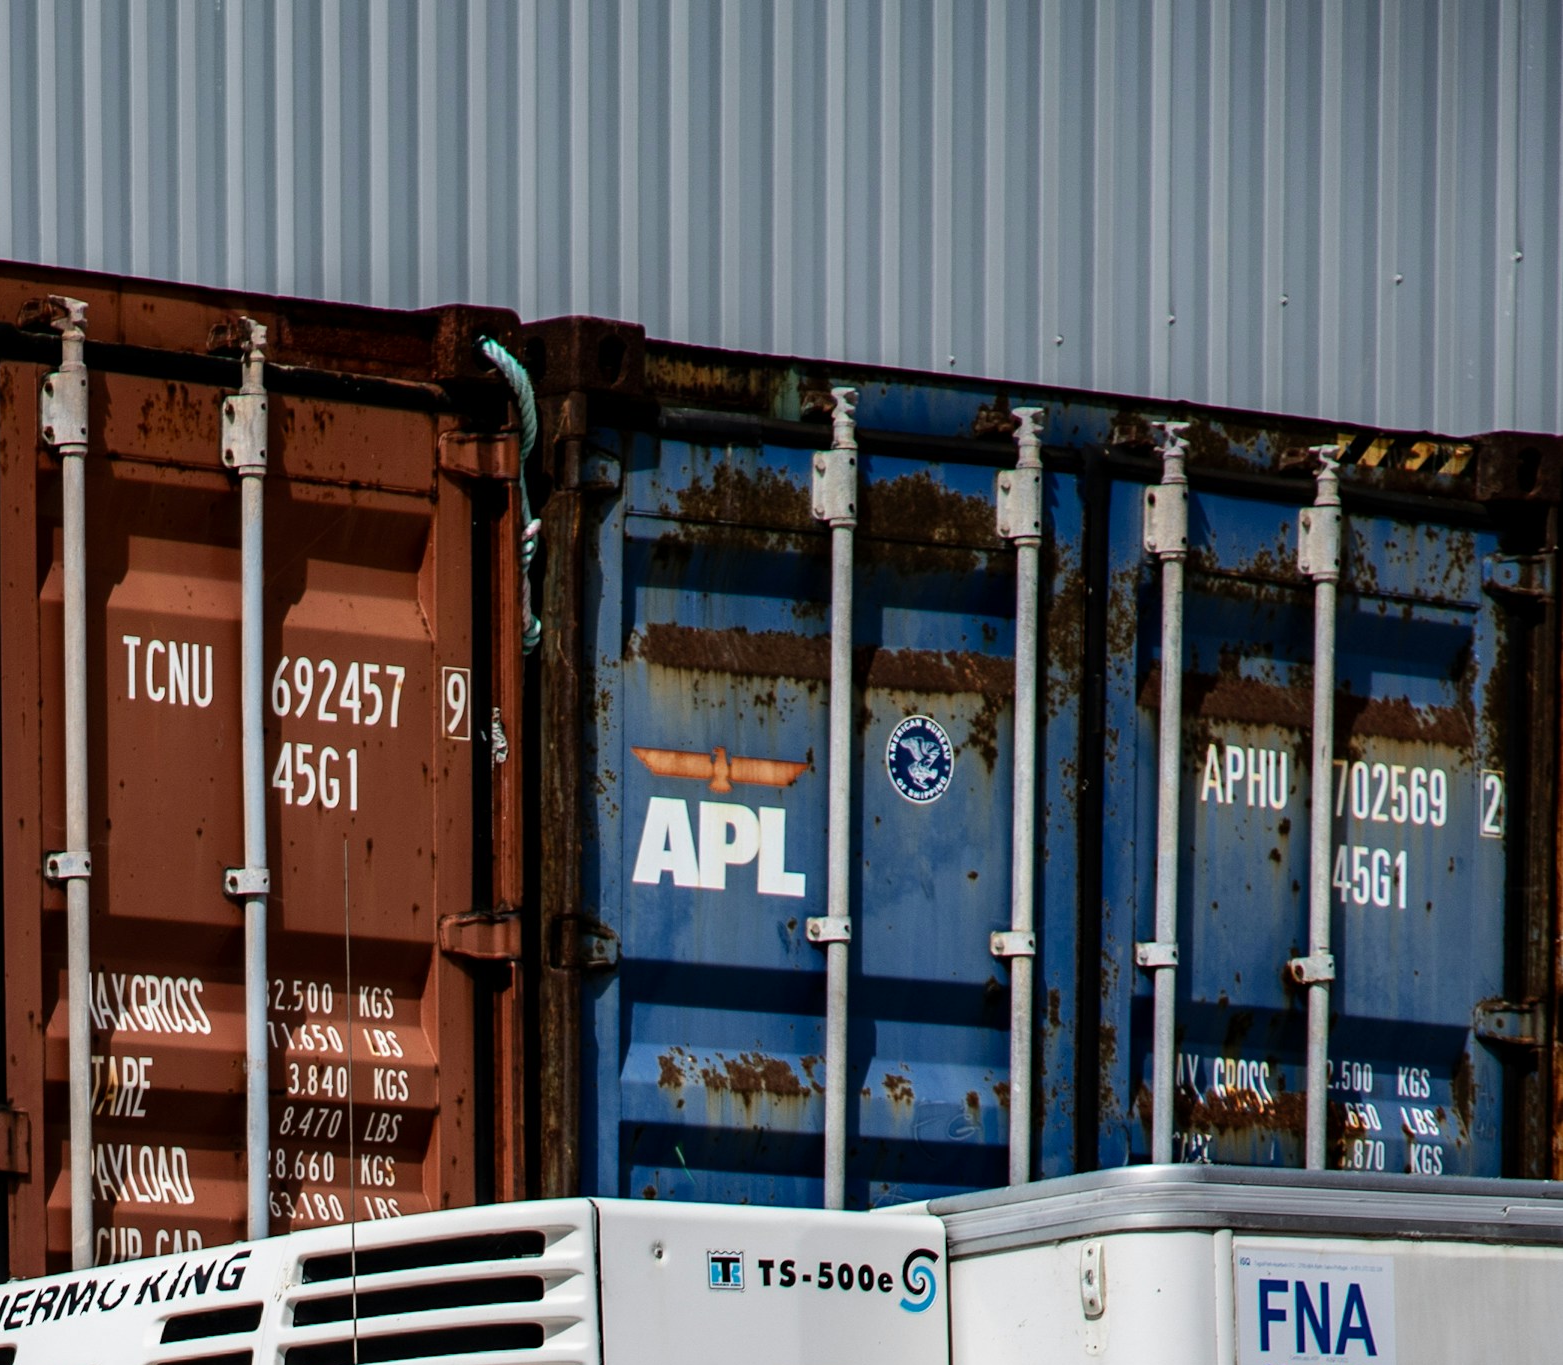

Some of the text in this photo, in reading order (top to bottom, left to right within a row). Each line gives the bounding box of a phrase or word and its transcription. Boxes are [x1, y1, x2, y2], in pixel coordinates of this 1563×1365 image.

[123, 635, 468, 734] TCNU 692457 9
[889, 719, 951, 761] AMERICAN BUREAU
[272, 741, 359, 811] 45G1
[896, 775, 948, 799] OF SHIPPING
[1200, 743, 1502, 834] APHU 702569 2
[632, 796, 807, 898] APL
[1333, 844, 1408, 909] 45G1
[131, 973, 211, 1035] GROSS
[359, 985, 394, 1019] KGS
[363, 1028, 404, 1058] LBS
[91, 1055, 153, 1117] TARE
[288, 1063, 409, 1101] 3,840 KGS
[1176, 1052, 1207, 1104] AX
[1398, 1065, 1431, 1099] KGS
[279, 1105, 402, 1143] 8,470 LBS
[1400, 1106, 1440, 1136] LBS
[91, 1143, 195, 1205] AYLOAD
[268, 1148, 396, 1187] 8,660 KGS
[1411, 1143, 1443, 1176] KGS
[135, 1250, 252, 1306] KING
[757, 1258, 894, 1293] TS-500e
[1258, 1278, 1378, 1357] FNA
